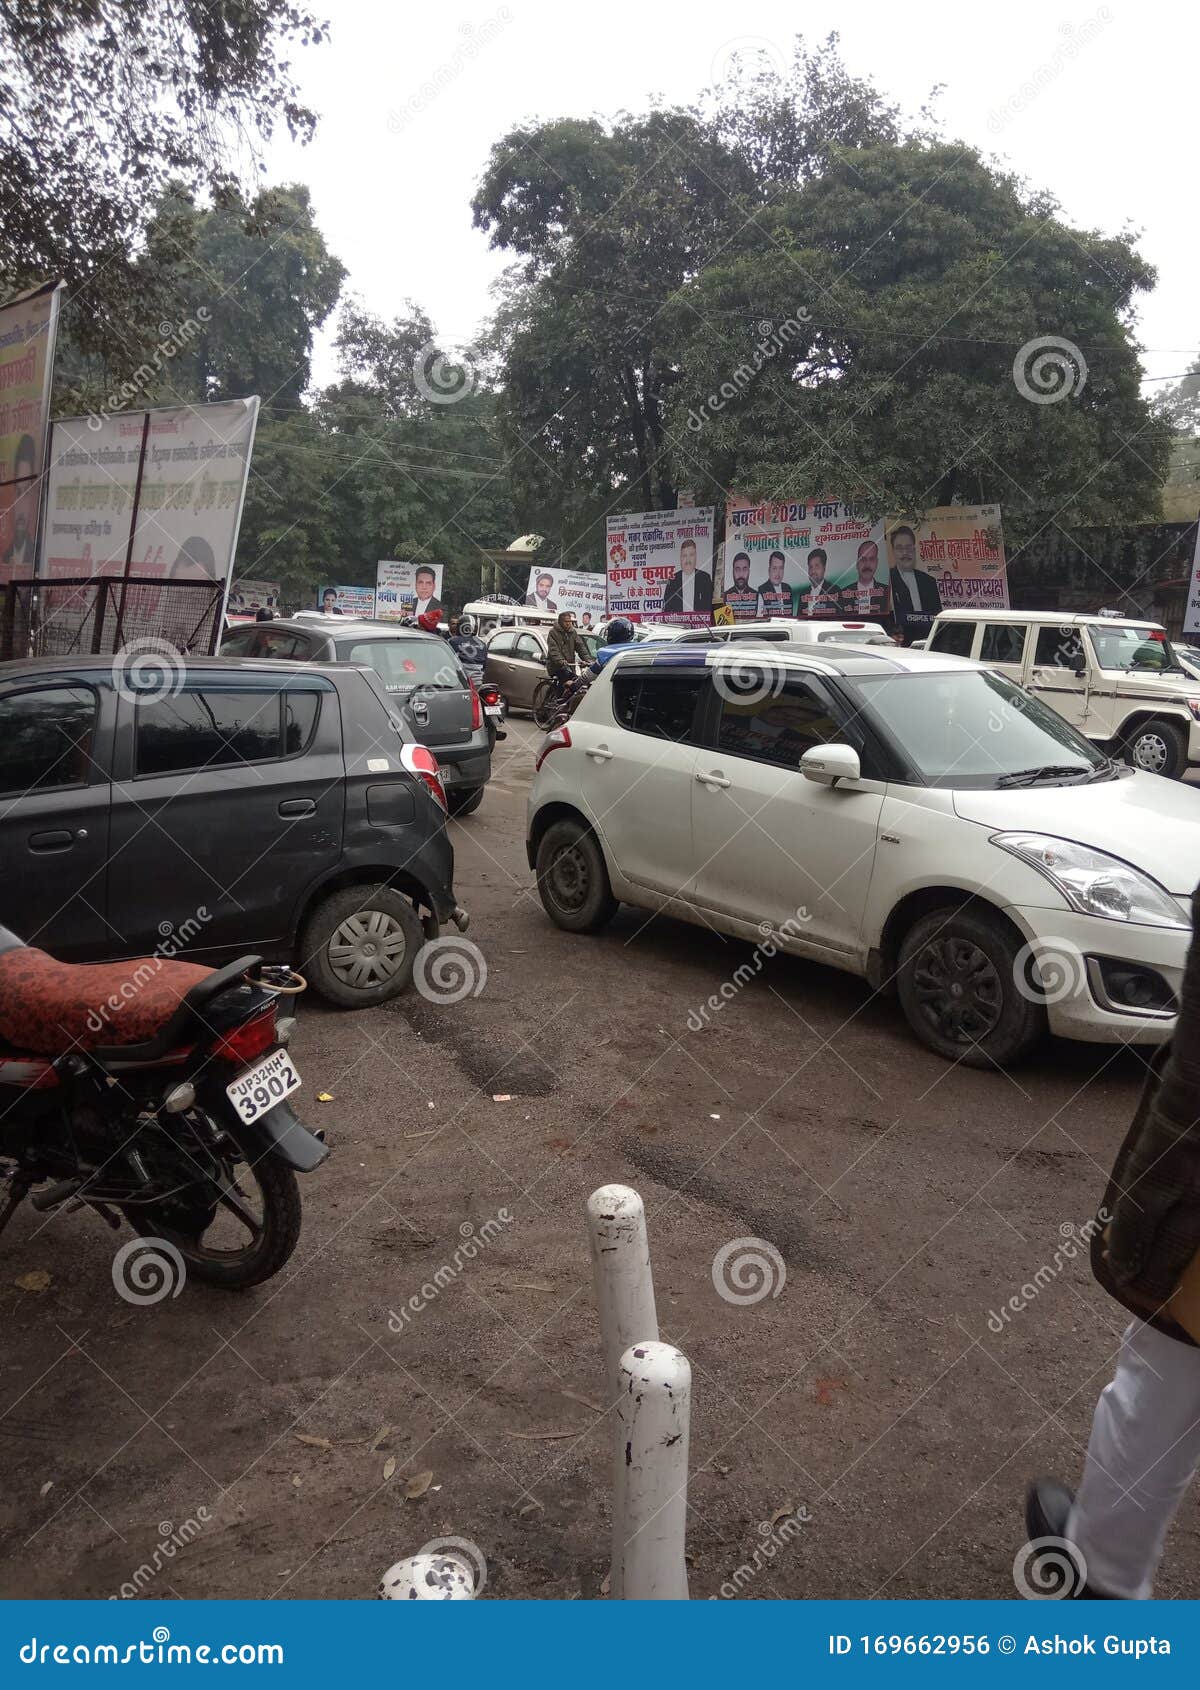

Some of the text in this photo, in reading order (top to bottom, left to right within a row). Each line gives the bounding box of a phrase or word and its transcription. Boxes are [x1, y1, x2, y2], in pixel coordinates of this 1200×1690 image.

[772, 503, 806, 523] 2020
[608, 565, 676, 587] कृष्ण कुमार
[237, 1057, 283, 1096] UP32HH
[239, 1066, 298, 1119] 3902
